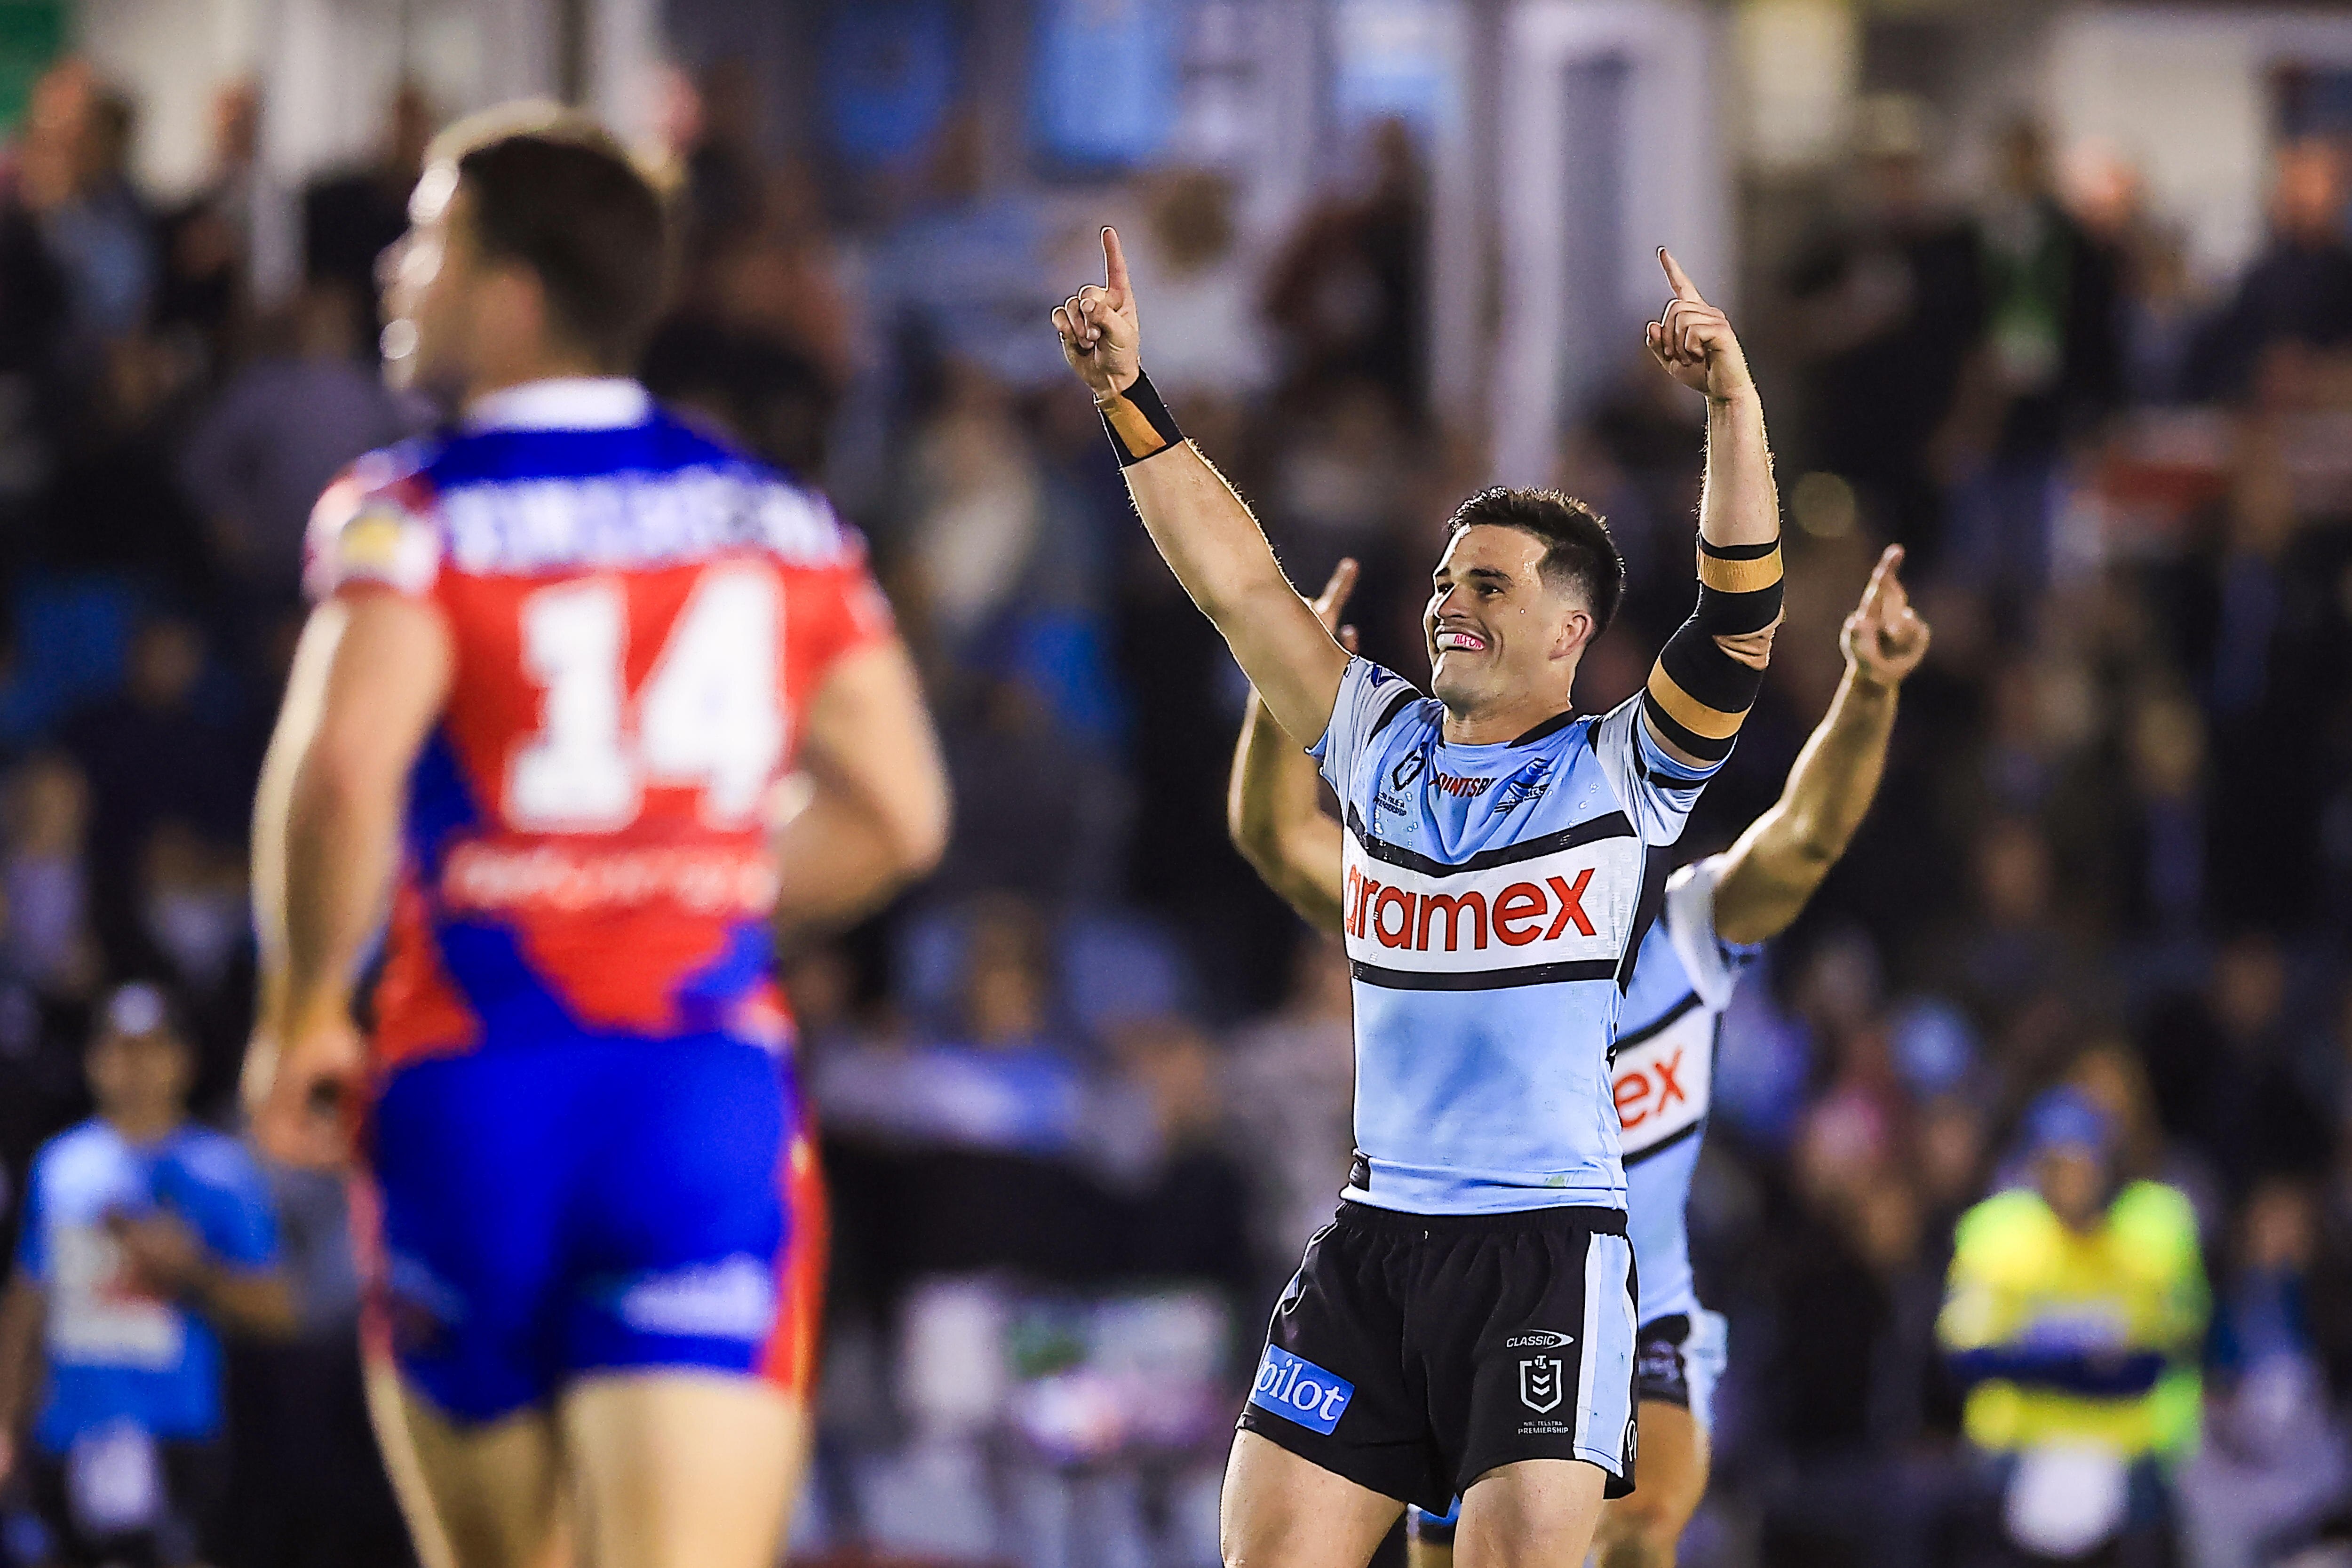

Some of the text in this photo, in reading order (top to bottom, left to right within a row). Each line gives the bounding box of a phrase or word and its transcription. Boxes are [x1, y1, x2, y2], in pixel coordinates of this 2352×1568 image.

[504, 561, 787, 834] 14
[1346, 864, 1597, 952] aramex
[1506, 1336, 1555, 1347] CLASSIC
[1252, 1358, 1345, 1421] pilot
